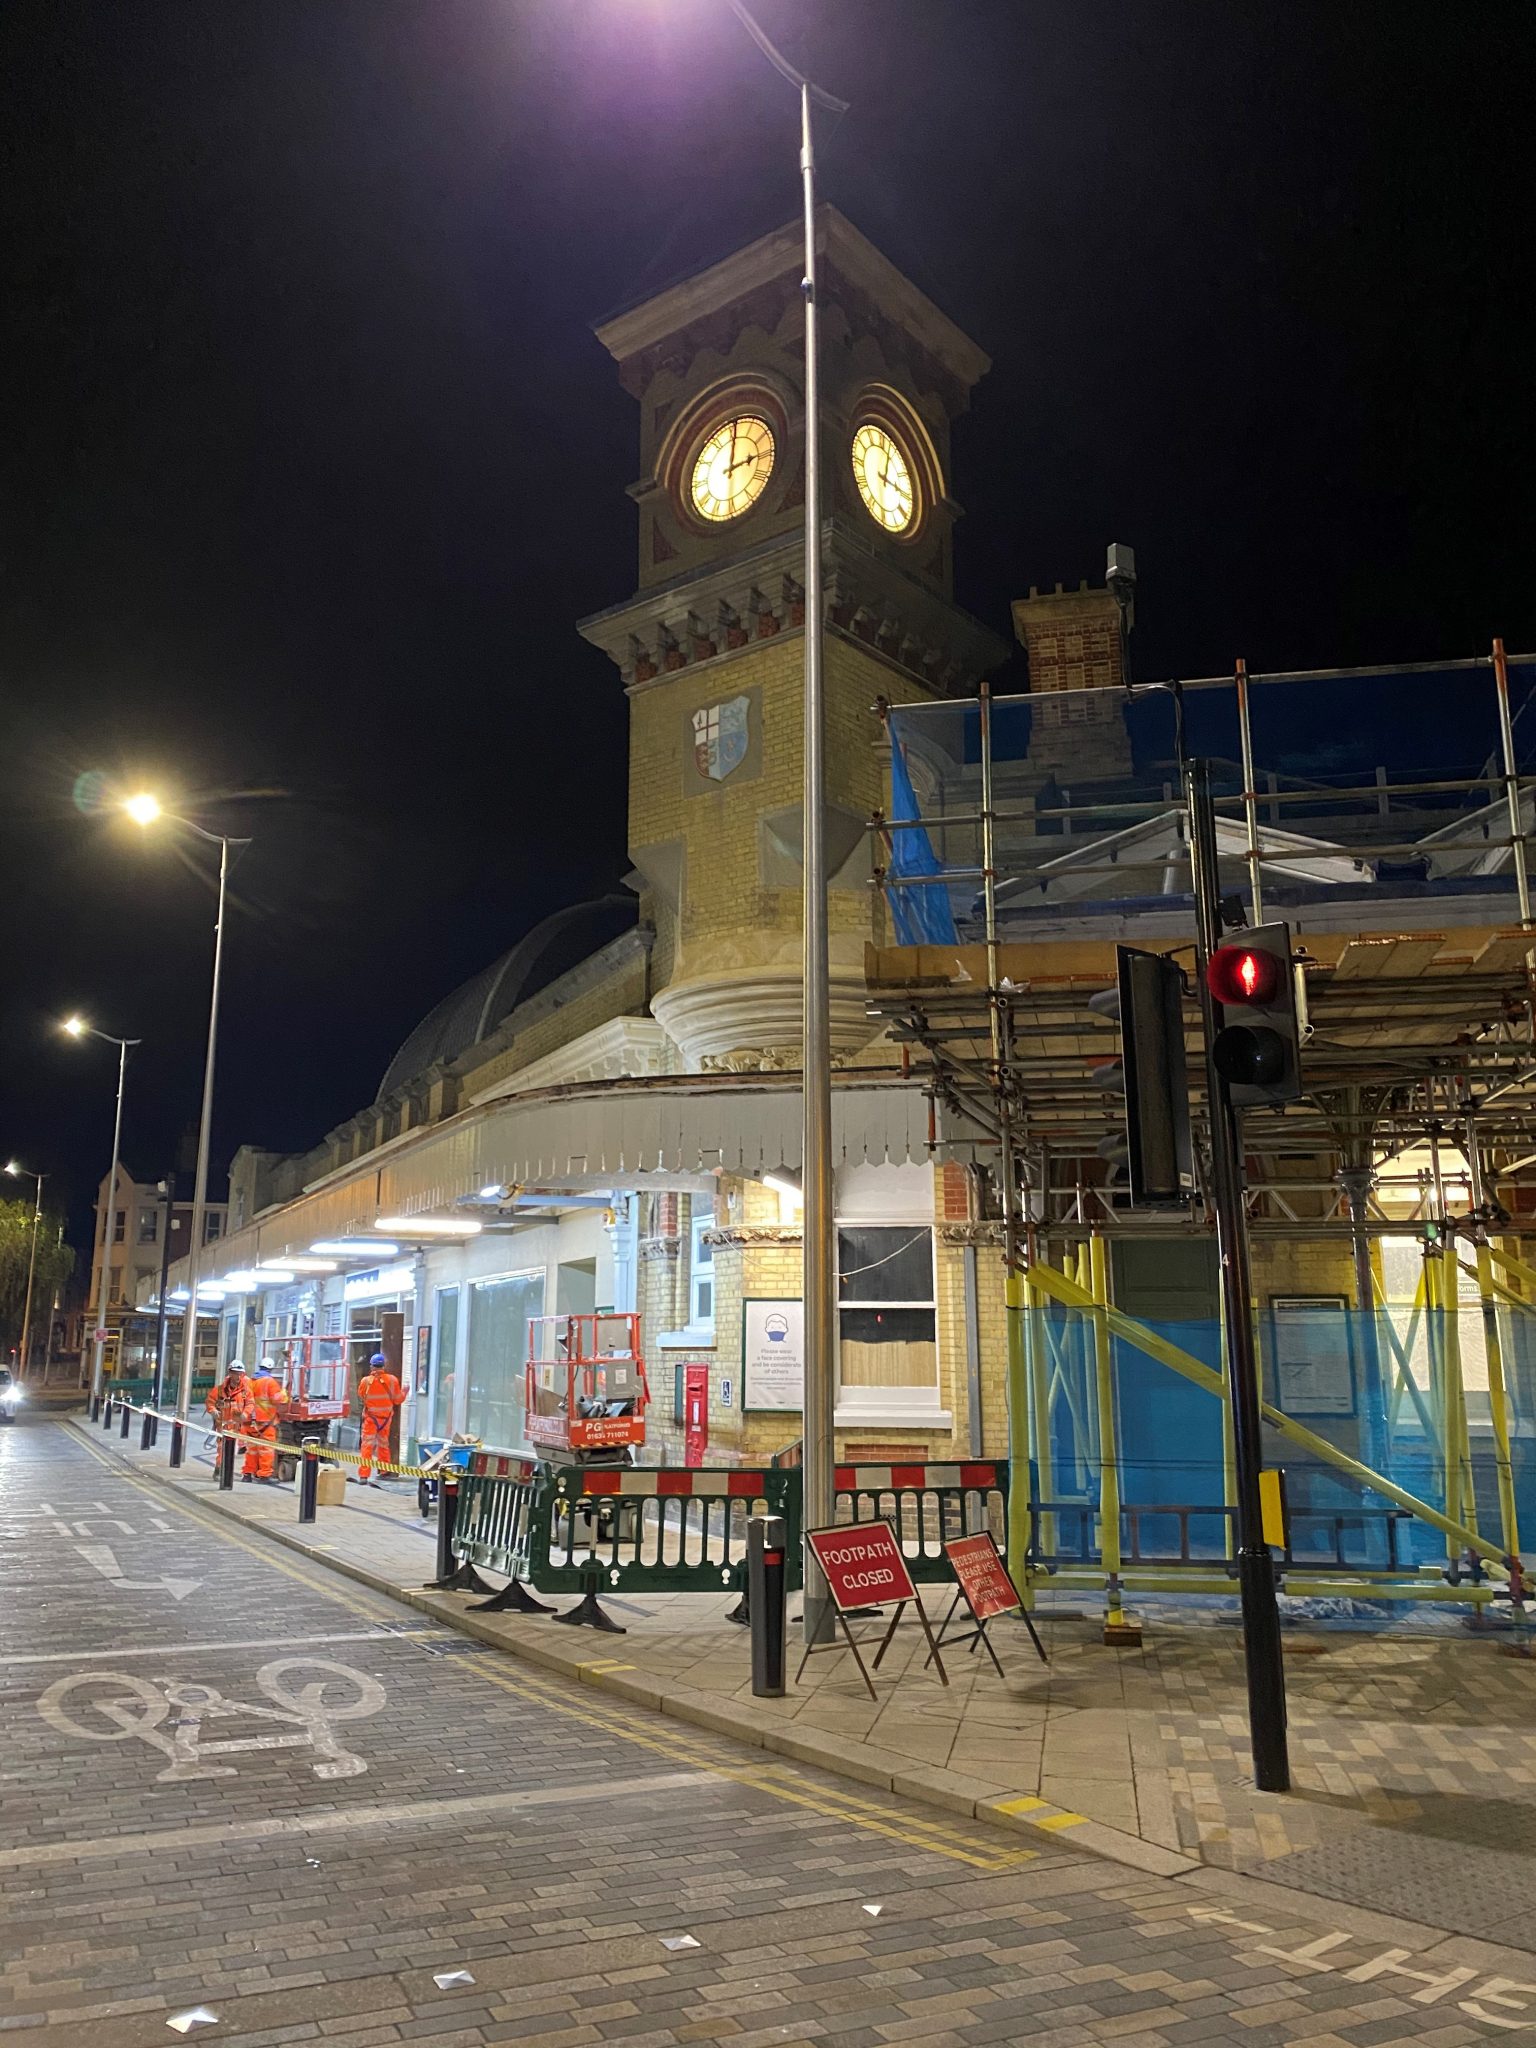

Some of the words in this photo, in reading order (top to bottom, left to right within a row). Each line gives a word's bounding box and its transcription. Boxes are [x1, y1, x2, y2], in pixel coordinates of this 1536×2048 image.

[585, 1423, 602, 1432] PG
[822, 1541, 894, 1566] FOOTPATH
[951, 1548, 994, 1568] PEDESTRIANS
[842, 1568, 894, 1590] CLOSED
[958, 1564, 983, 1580] PLEASE
[982, 1560, 998, 1573] USE
[972, 1575, 995, 1590] OTHER
[973, 1585, 1006, 1604] FOOTPATH
